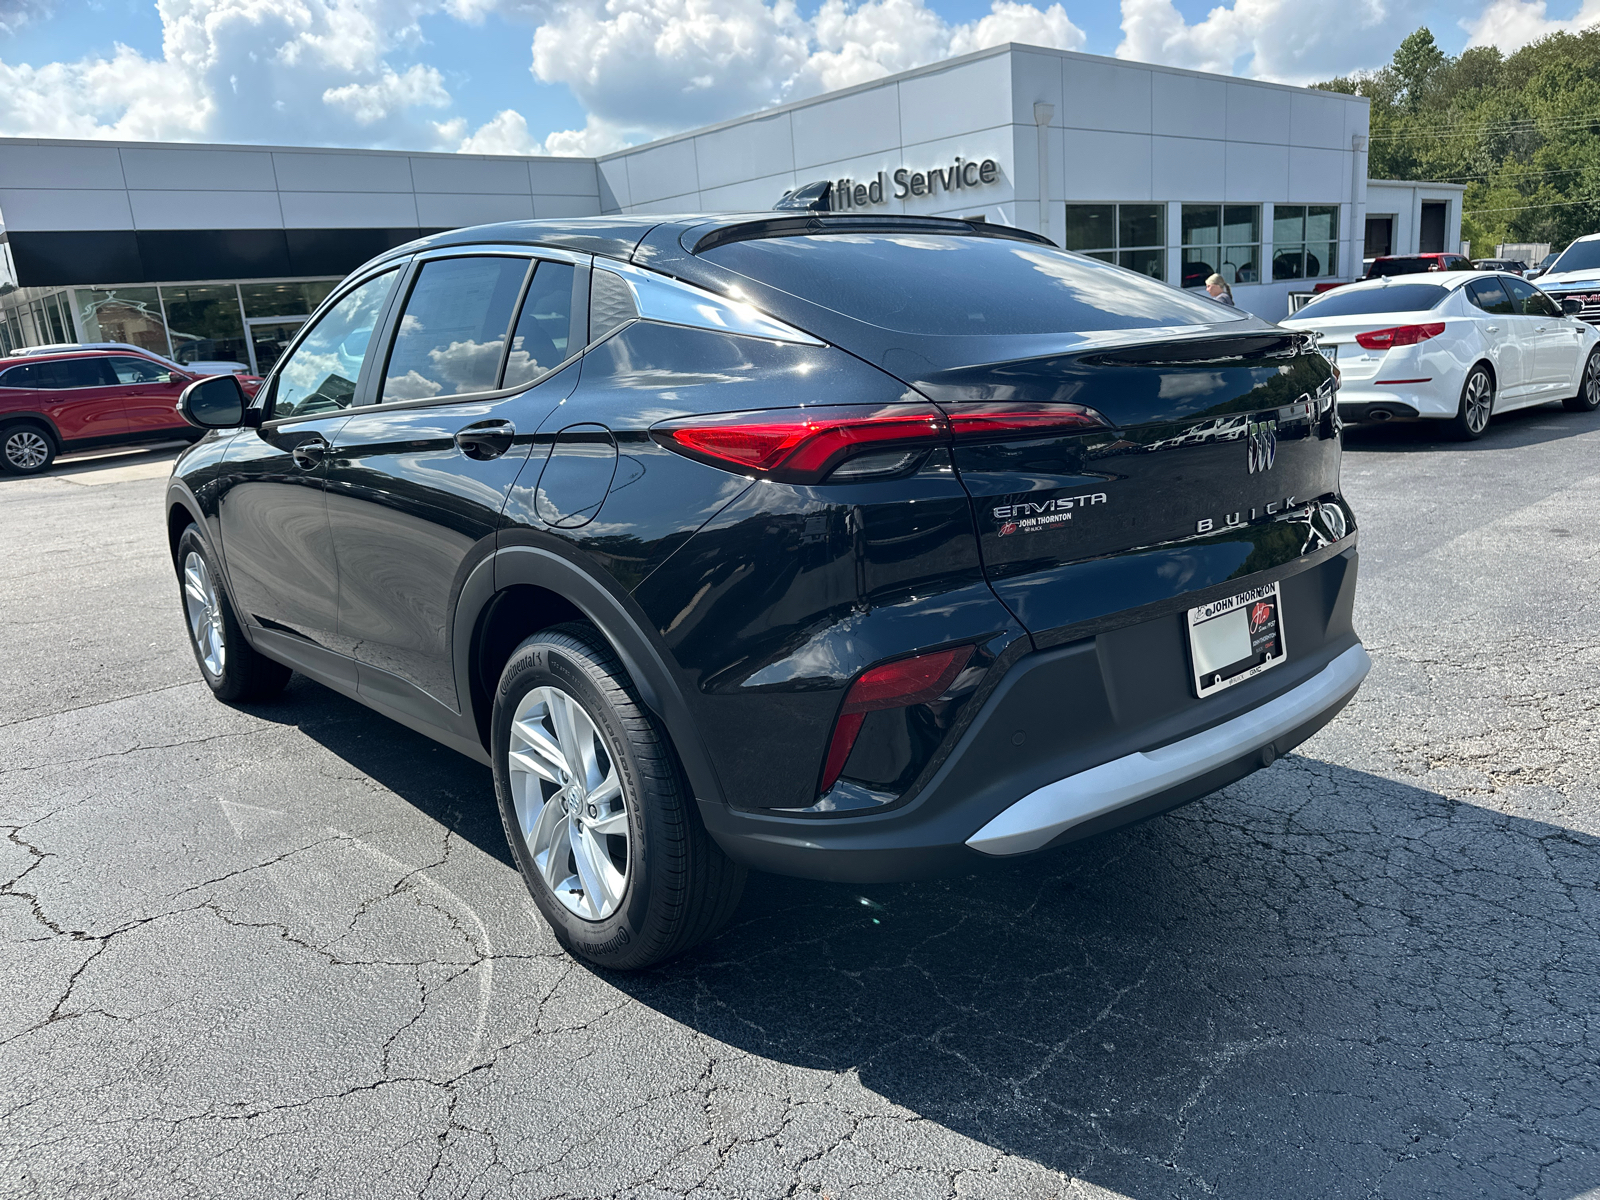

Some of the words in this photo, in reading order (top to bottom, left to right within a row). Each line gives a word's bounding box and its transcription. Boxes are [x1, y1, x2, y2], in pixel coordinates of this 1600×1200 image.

[894, 157, 996, 200] Service
[993, 492, 1107, 519] ENVISTA
[1019, 518, 1037, 528] JOHN
[1038, 512, 1072, 525] THORNTON
[1197, 495, 1296, 533] BUICK
[1212, 597, 1234, 614] JOHN
[500, 652, 536, 696] Continental
[583, 926, 630, 957] Continental
